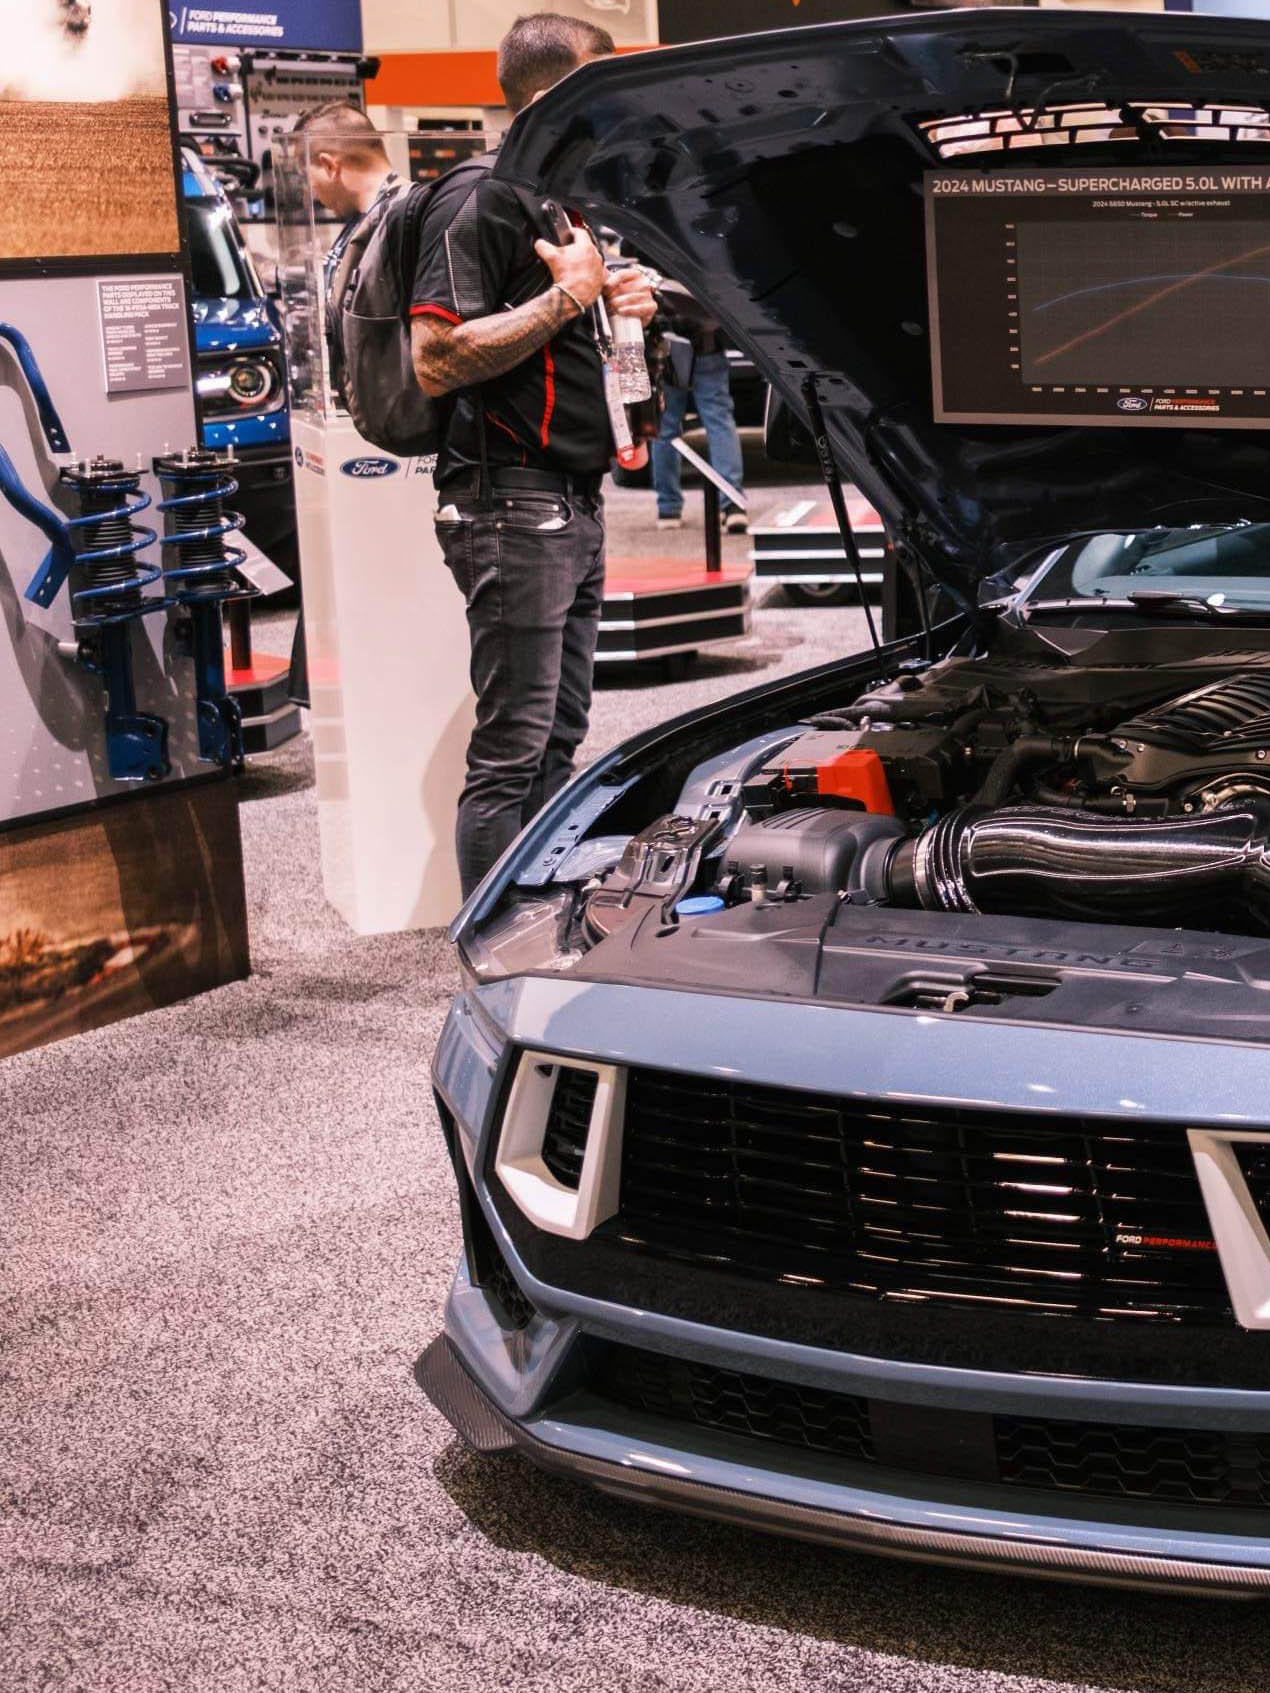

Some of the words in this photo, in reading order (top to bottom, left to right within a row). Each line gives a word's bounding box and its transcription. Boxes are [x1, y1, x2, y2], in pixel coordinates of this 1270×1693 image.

[189, 9, 213, 21] FORD
[213, 11, 278, 25] PERFORMANCE
[187, 21, 217, 33] PARTS
[225, 24, 284, 37] ACCESSORIES
[932, 179, 969, 193] 2024
[1186, 177, 1218, 190] 5.0L
[1221, 176, 1262, 190] WITH
[1092, 200, 1108, 208] 2024
[1126, 200, 1152, 209] Mustang
[1206, 199, 1231, 207] exhaust
[351, 459, 389, 476] Ford
[418, 455, 438, 464] FOR
[865, 935, 1158, 969] MUSTANG
[1115, 1234, 1142, 1245] FORD
